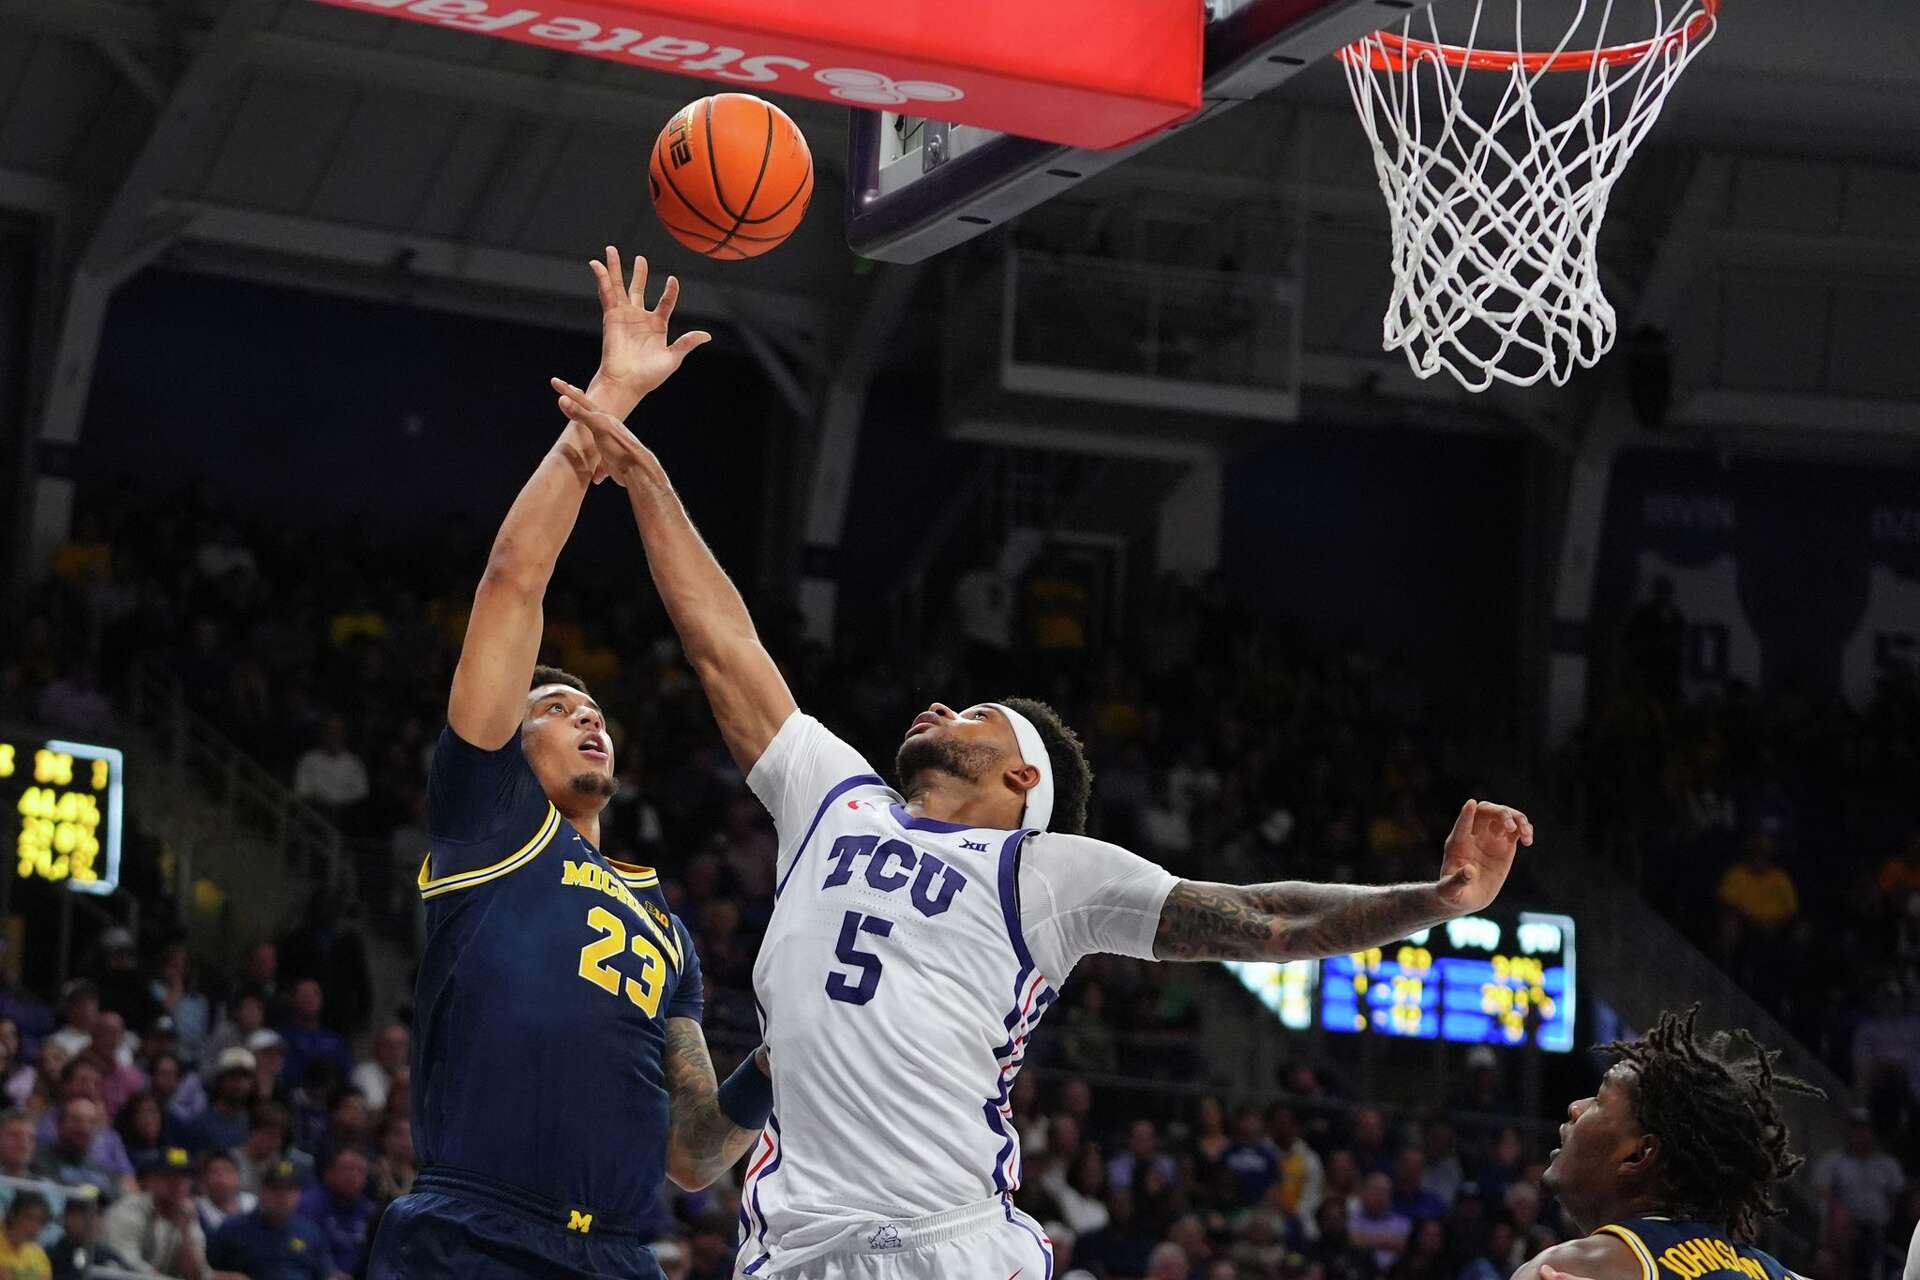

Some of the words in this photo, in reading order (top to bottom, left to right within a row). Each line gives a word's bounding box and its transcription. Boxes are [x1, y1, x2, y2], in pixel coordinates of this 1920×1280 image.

[821, 835, 968, 918] TCU
[958, 837, 991, 853] XII
[578, 906, 667, 1020] 23
[824, 910, 895, 1006] 5
[567, 1210, 593, 1233] M
